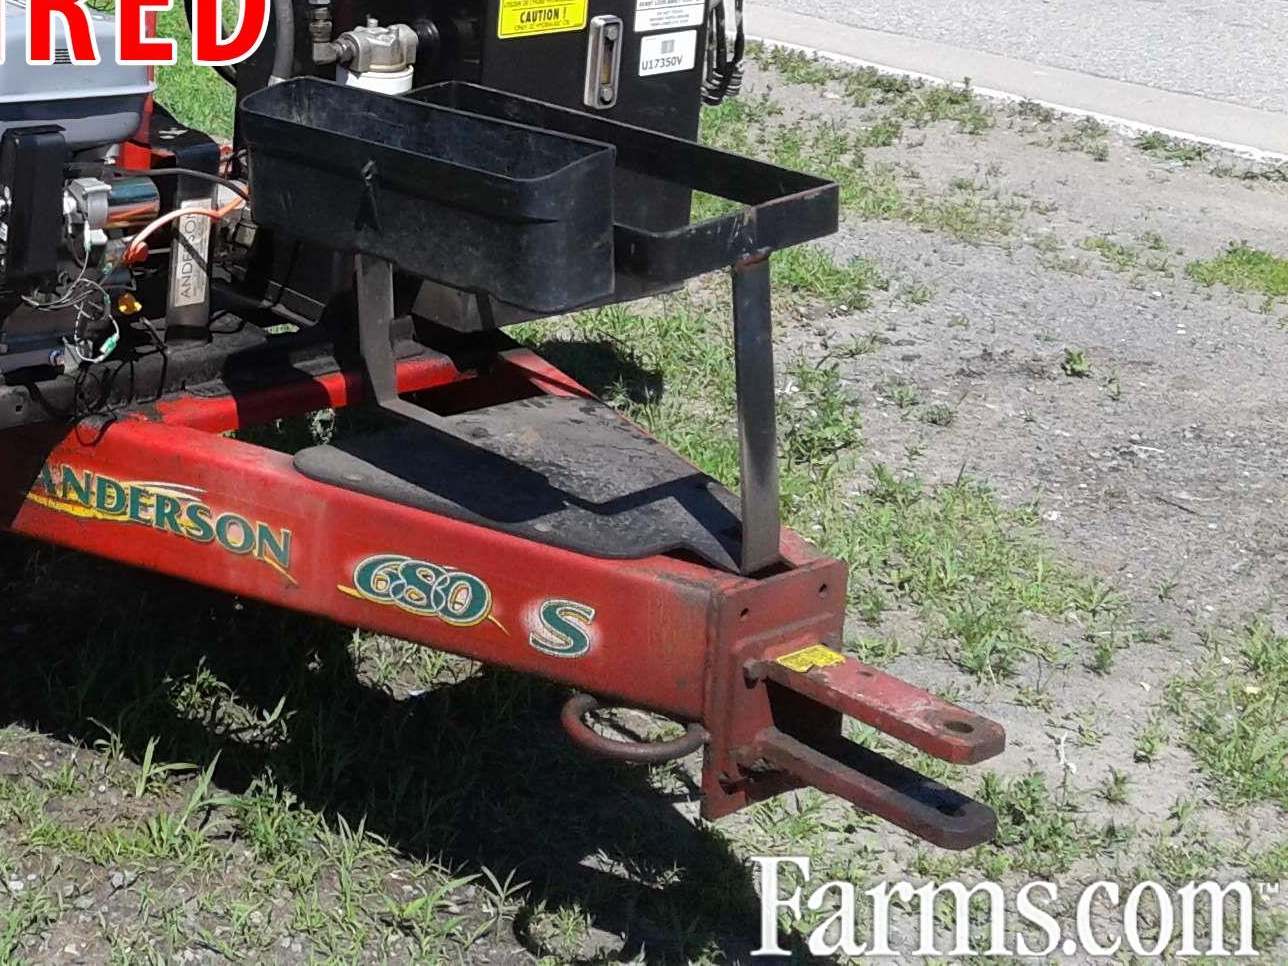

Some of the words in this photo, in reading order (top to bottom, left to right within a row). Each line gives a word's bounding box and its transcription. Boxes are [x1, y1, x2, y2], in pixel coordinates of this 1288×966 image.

[520, 8, 560, 24] CAUTION
[642, 53, 683, 71] U17350V
[352, 553, 494, 627] 680
[528, 598, 596, 658] S
